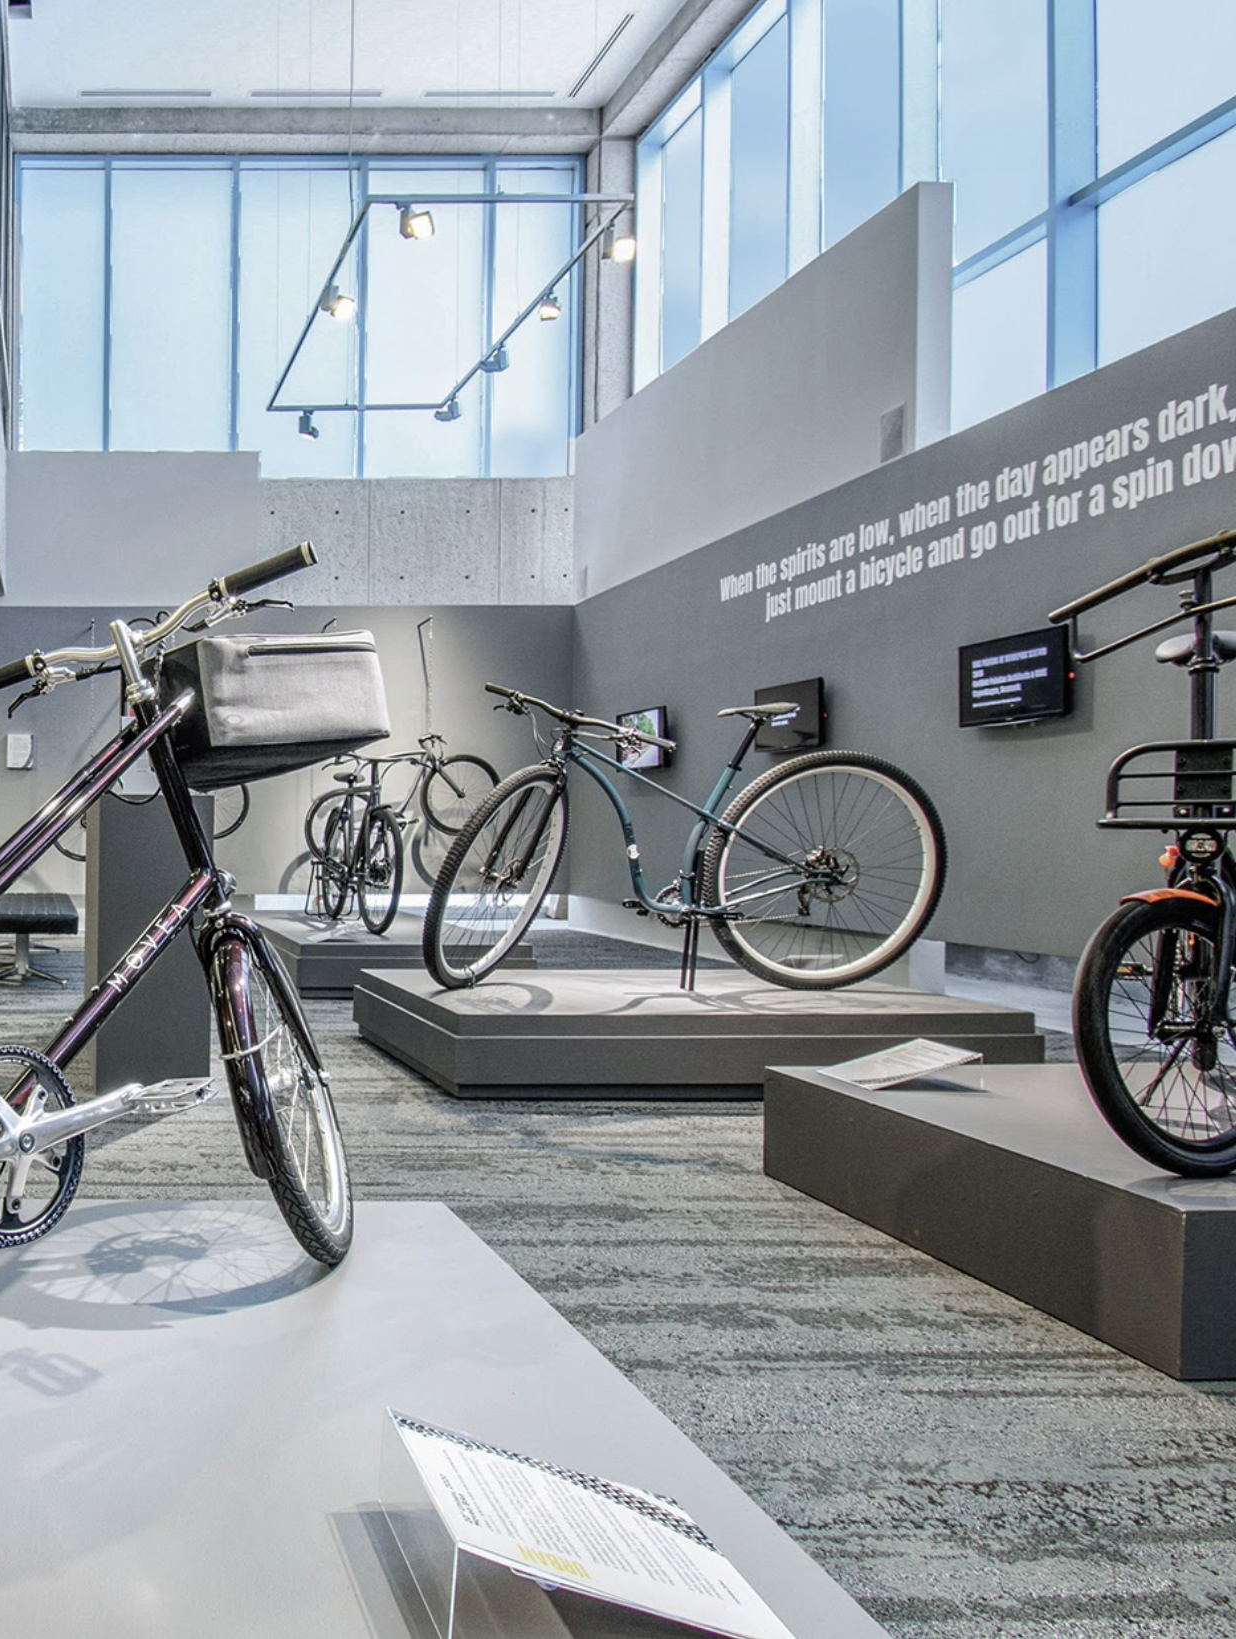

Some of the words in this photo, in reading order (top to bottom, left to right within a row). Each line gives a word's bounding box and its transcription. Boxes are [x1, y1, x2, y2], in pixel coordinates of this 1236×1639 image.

[720, 570, 754, 602] When
[756, 562, 778, 590] the
[780, 542, 826, 582] spirits
[829, 532, 855, 563] are
[859, 518, 895, 553] low,
[899, 495, 951, 538] when
[956, 479, 990, 517] the
[995, 460, 1038, 503] day
[1042, 416, 1151, 486] appears
[1158, 383, 1236, 443] dark,
[765, 586, 792, 623] just
[795, 569, 843, 610] mount
[846, 568, 856, 594] a
[859, 545, 923, 591] bicycle
[927, 527, 965, 569] and
[970, 520, 997, 560] go
[1003, 500, 1041, 544] out
[1046, 490, 1083, 531] for
[1088, 483, 1106, 517] a
[1112, 457, 1175, 510] spin
[517, 1543, 593, 1580] URBAN
